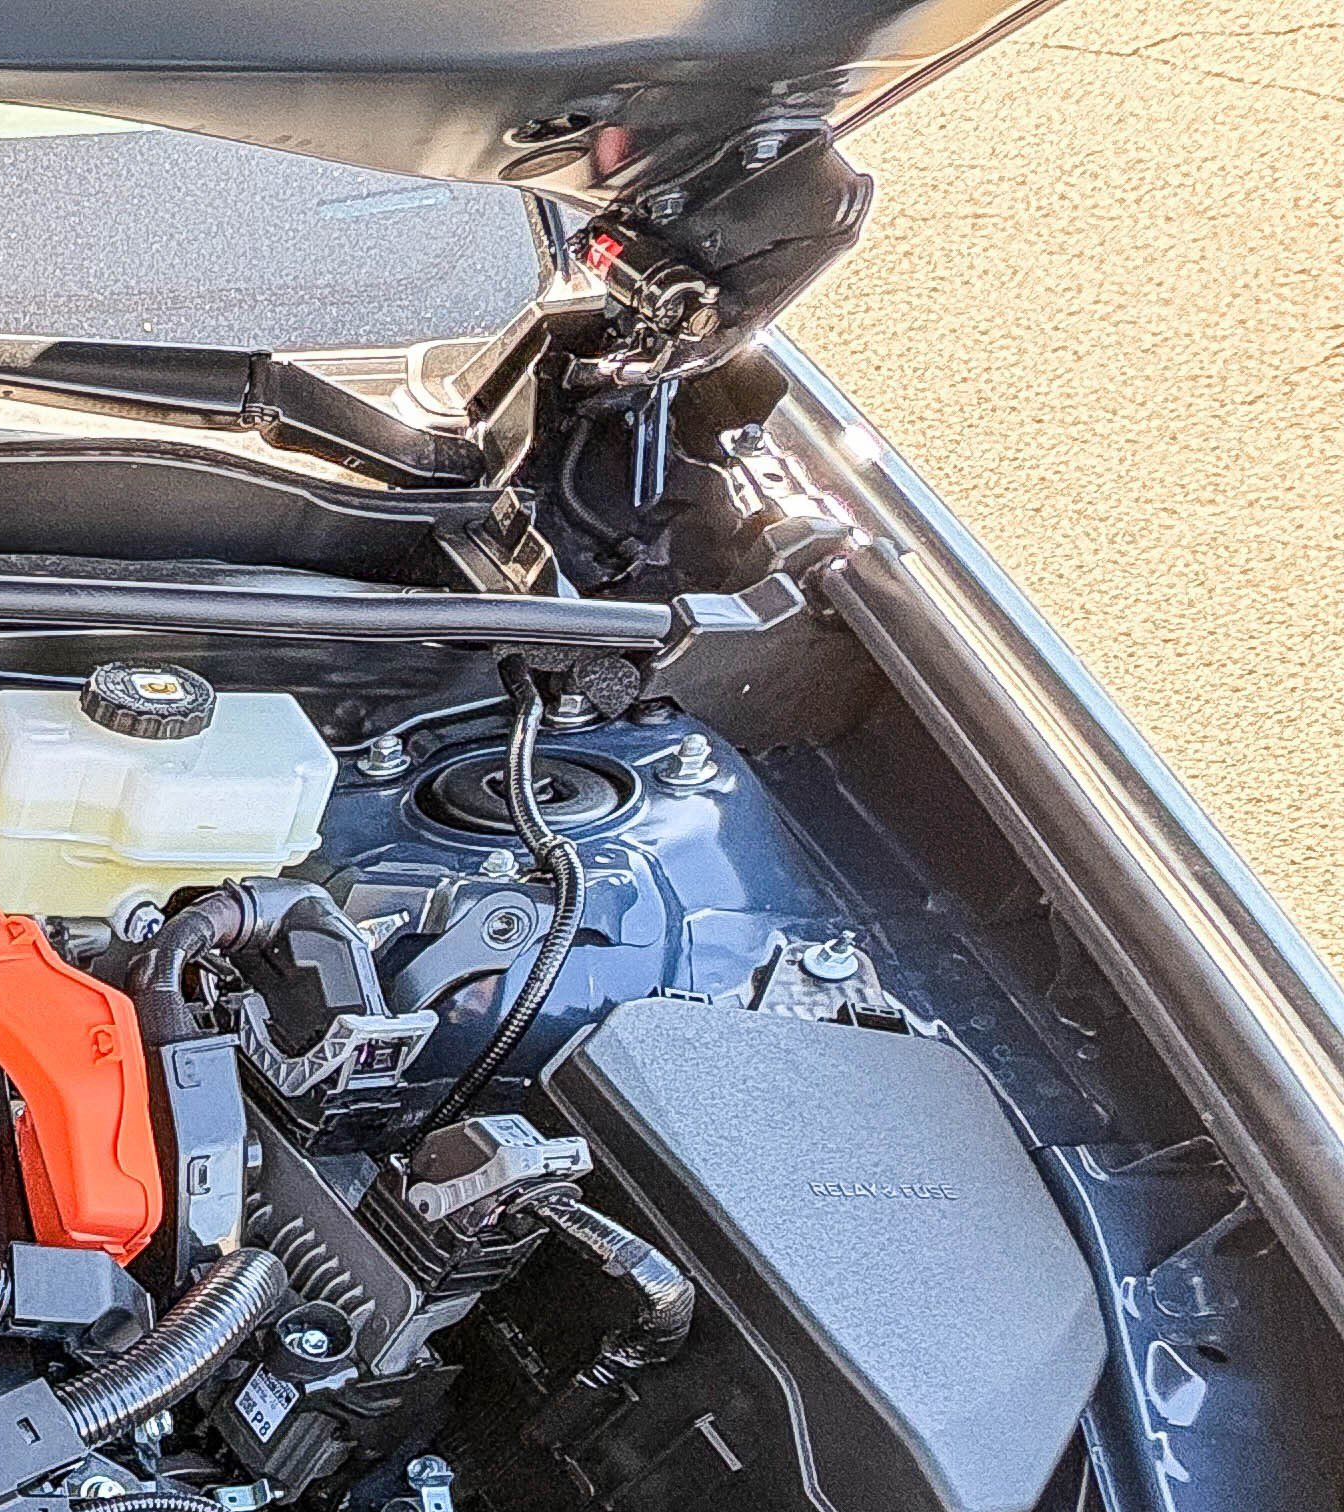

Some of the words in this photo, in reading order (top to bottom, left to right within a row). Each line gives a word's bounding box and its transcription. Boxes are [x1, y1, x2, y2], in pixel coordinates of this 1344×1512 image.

[809, 1181, 877, 1198] RELAY
[880, 1183, 897, 1199] &
[899, 1183, 961, 1200] FUSE
[251, 1411, 272, 1438] P8
